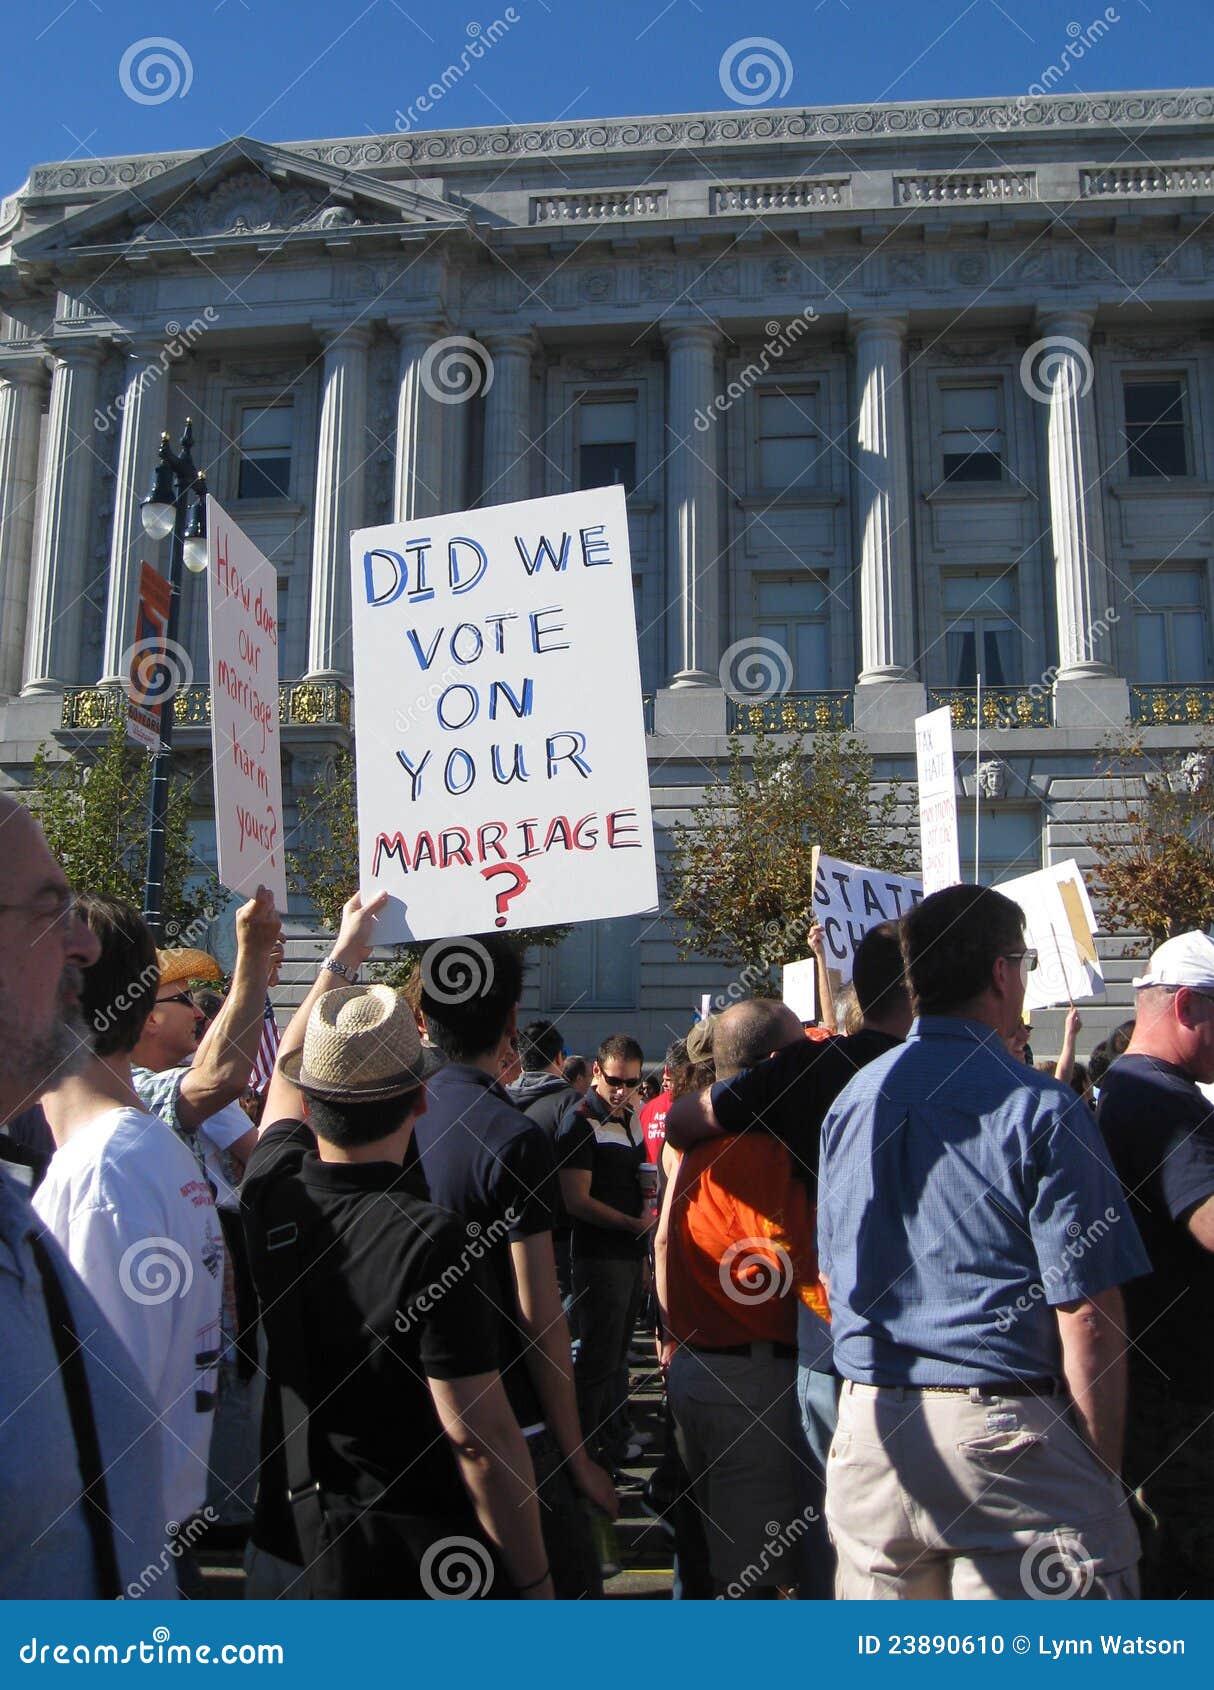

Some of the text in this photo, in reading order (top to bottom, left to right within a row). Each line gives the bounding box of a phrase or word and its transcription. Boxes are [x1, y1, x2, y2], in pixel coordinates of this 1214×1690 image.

[217, 526, 277, 645] How does
[363, 525, 613, 607] DID WE
[238, 629, 261, 673] our
[406, 605, 572, 671] VOTE
[218, 659, 273, 754] marriage
[437, 678, 533, 731] ON
[232, 720, 268, 797] harm
[396, 731, 592, 801] YOUR
[236, 805, 277, 868] yours?
[372, 808, 643, 877] MARRIAGE
[480, 861, 531, 928] ?
